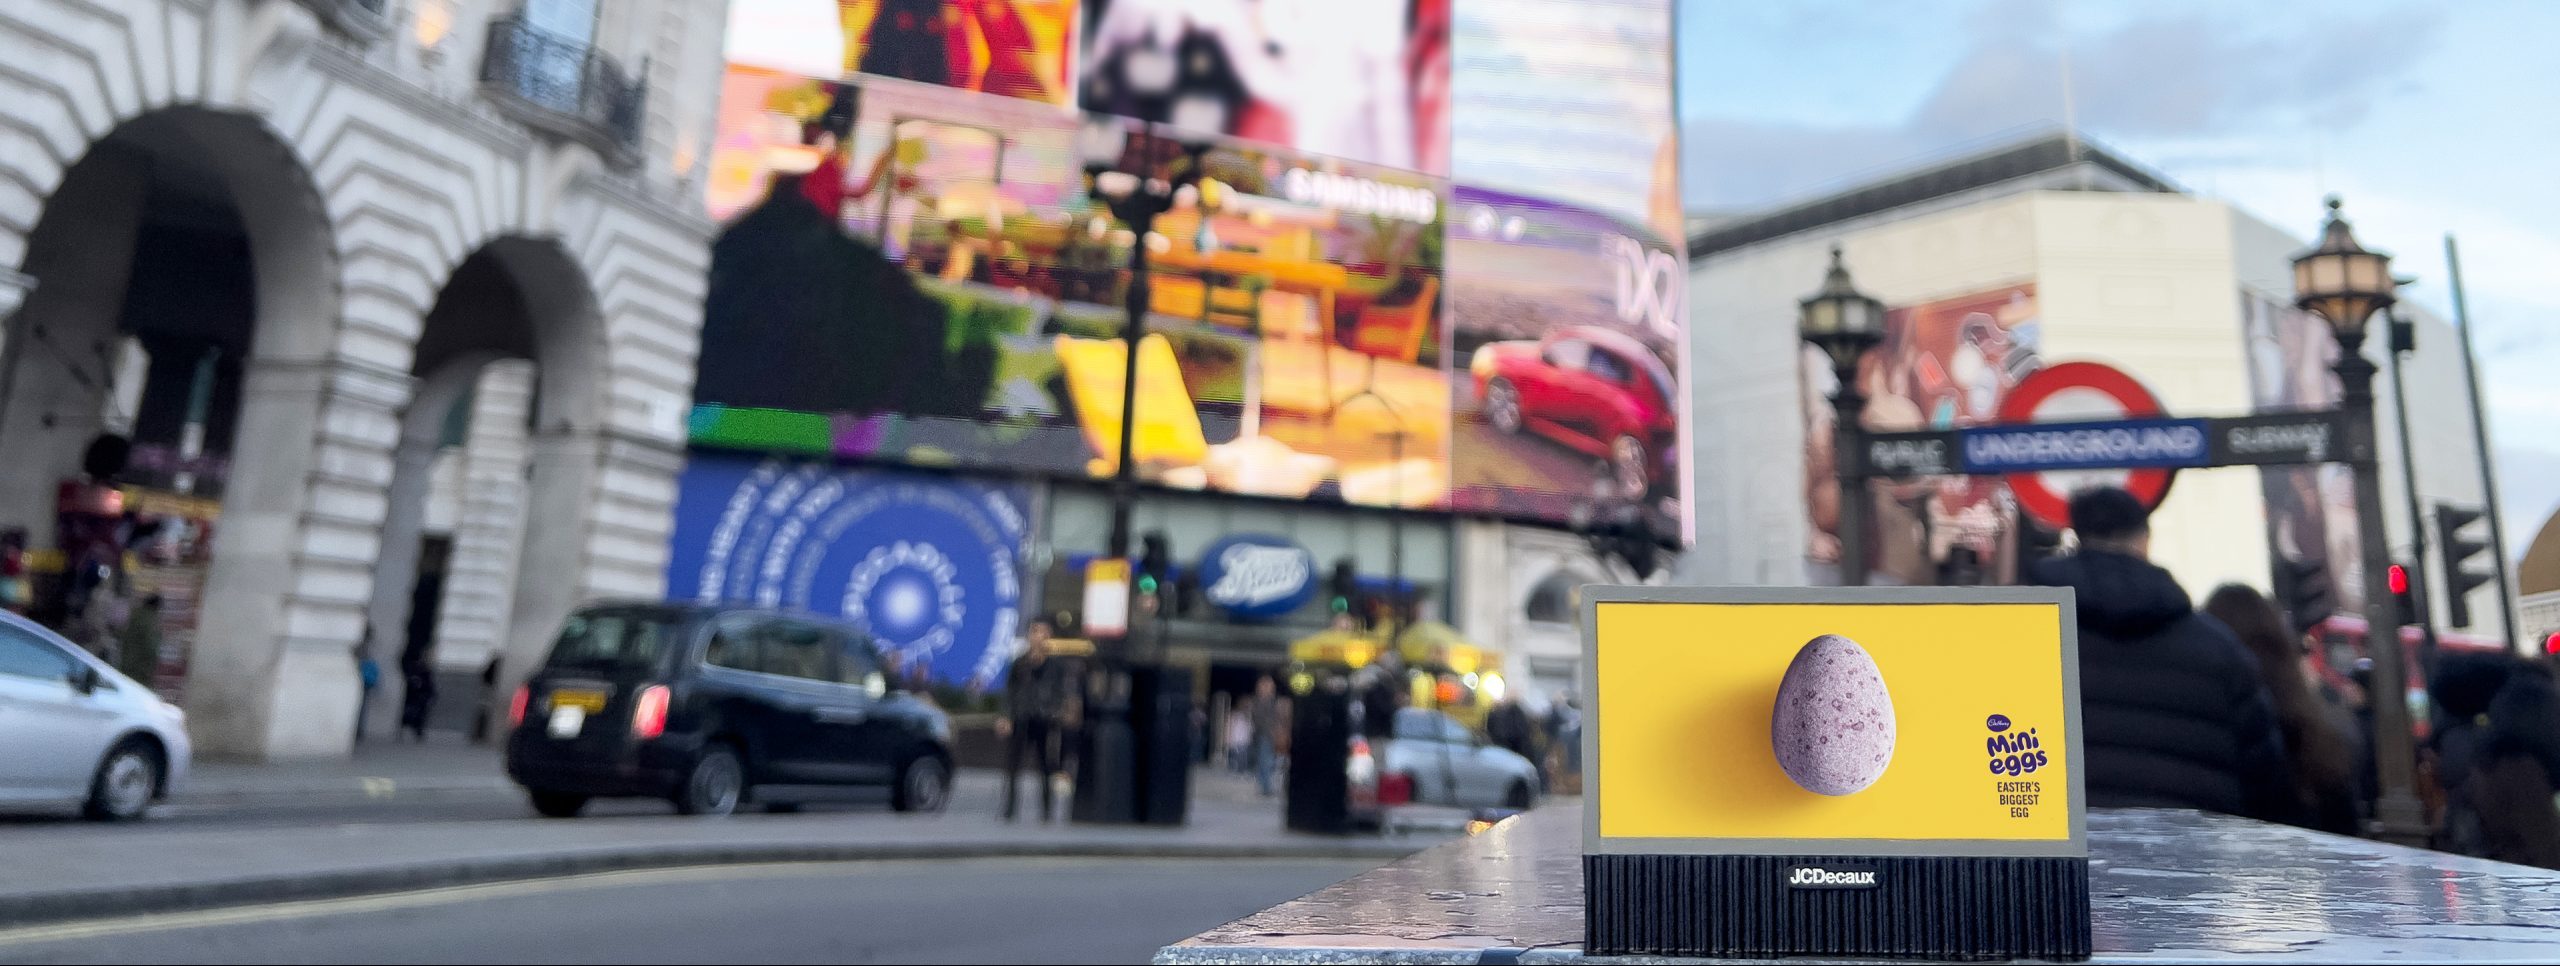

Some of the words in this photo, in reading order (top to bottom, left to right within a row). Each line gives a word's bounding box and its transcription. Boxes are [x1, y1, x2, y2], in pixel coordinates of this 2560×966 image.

[1966, 425, 2206, 465] UNDERGROUND
[2226, 422, 2329, 454] SUBWAY
[1987, 718, 2010, 728] Cadbury
[1986, 727, 2040, 757] Mini
[1989, 750, 2048, 777] eggs
[1997, 781, 2041, 793] EASTER'S
[1999, 794, 2039, 806] BIGGEST
[2010, 806, 2029, 818] EGG
[1790, 867, 1876, 884] JCDecaux
